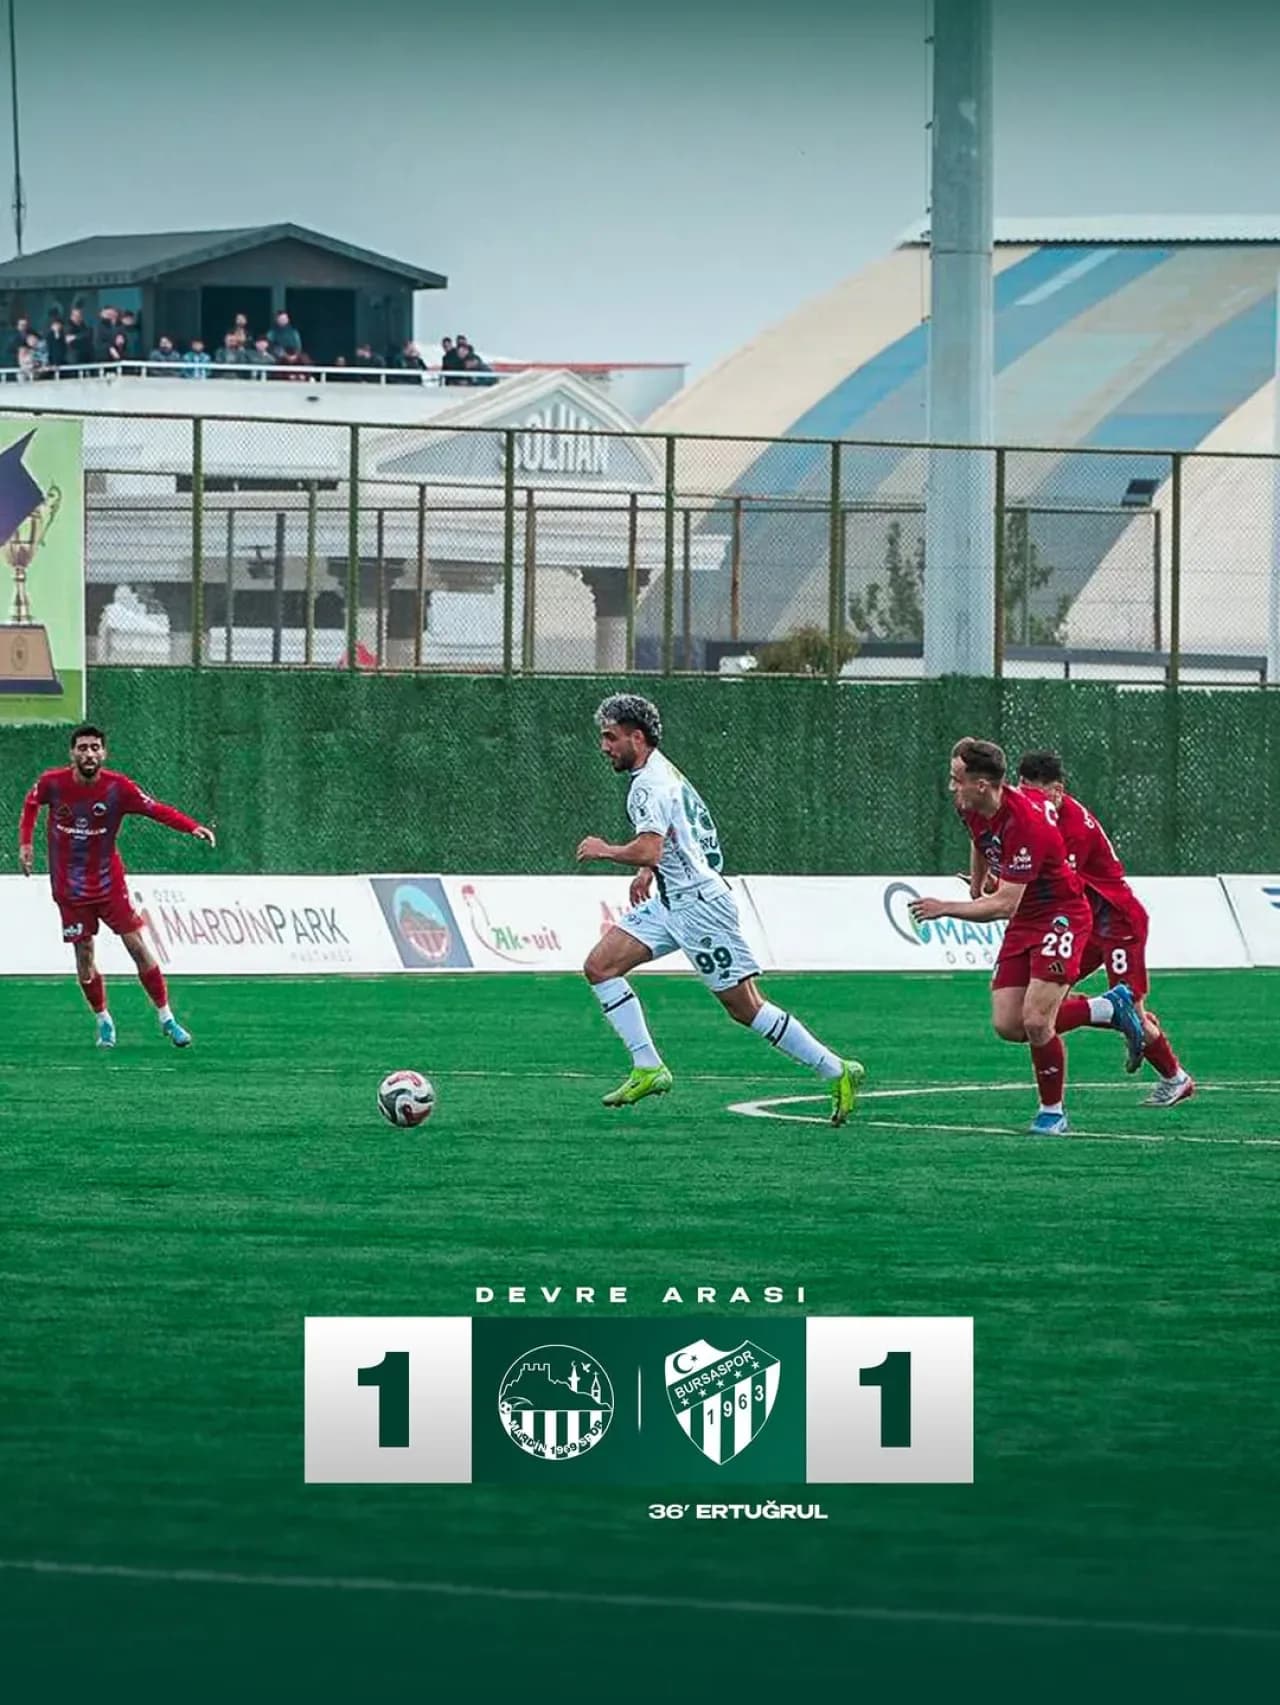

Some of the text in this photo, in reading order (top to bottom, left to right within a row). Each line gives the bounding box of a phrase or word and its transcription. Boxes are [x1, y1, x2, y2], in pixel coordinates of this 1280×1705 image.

[1041, 931, 1074, 959] 28
[696, 946, 732, 974] 99
[1111, 948, 1128, 974] 8
